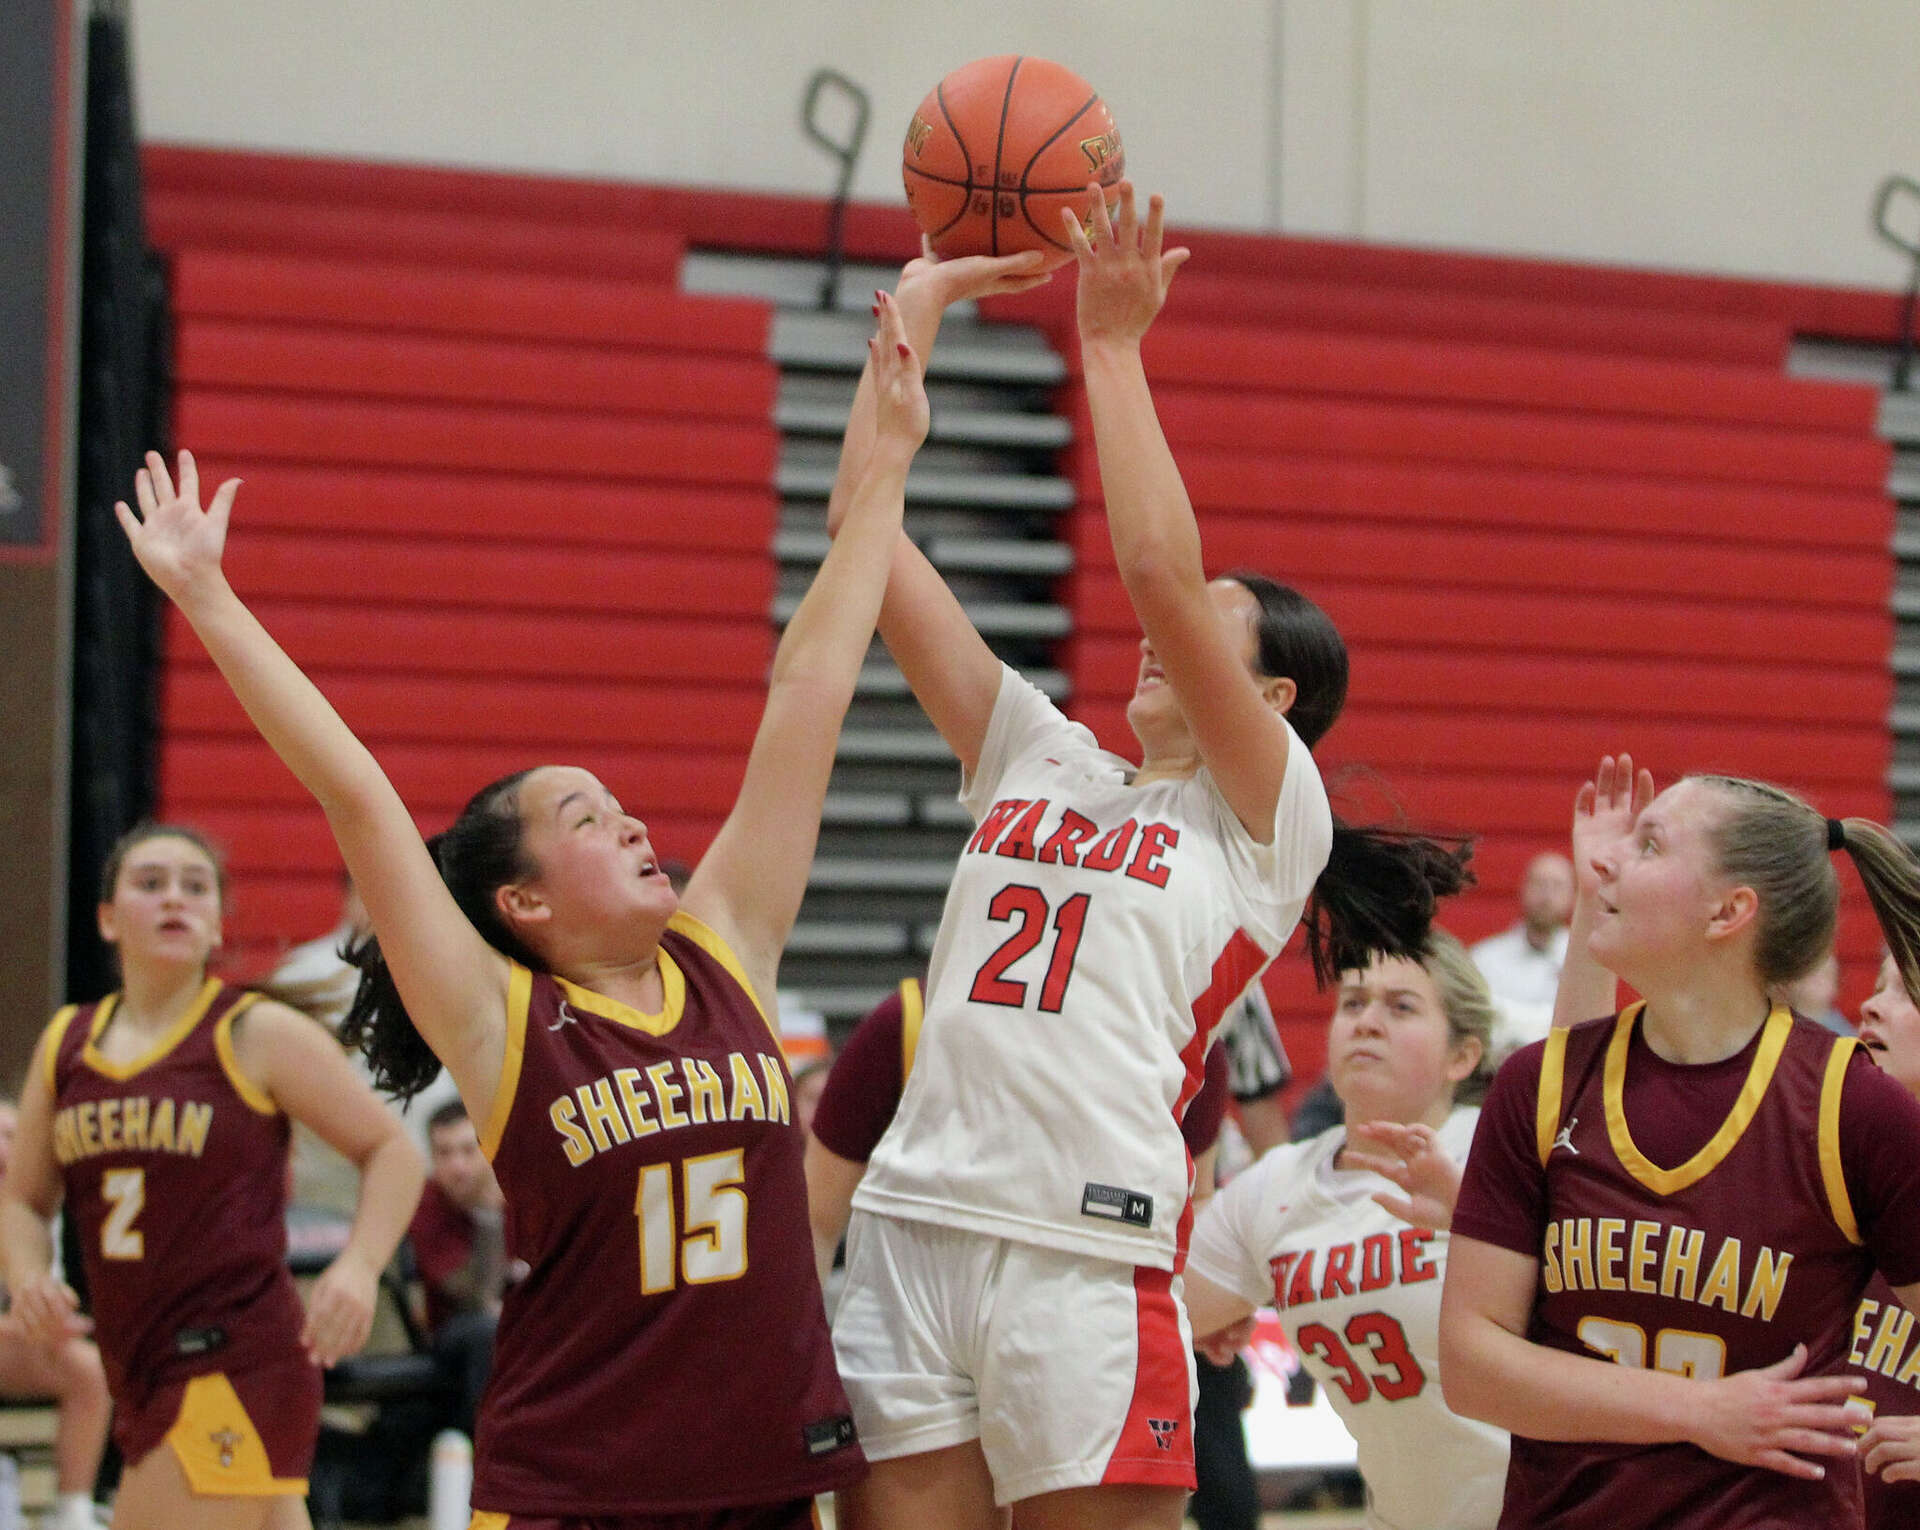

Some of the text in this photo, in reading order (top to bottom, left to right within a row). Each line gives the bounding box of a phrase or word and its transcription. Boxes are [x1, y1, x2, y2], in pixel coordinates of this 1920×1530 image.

[967, 798, 1180, 890] WARDE
[967, 882, 1092, 1015] 21
[549, 1052, 791, 1168] SHEEHAN
[102, 1167, 146, 1261] 2
[634, 1147, 749, 1296] 15
[1131, 1200, 1145, 1217] M
[1544, 1217, 1795, 1323] SHEEHAN
[1296, 1310, 1427, 1405] 33
